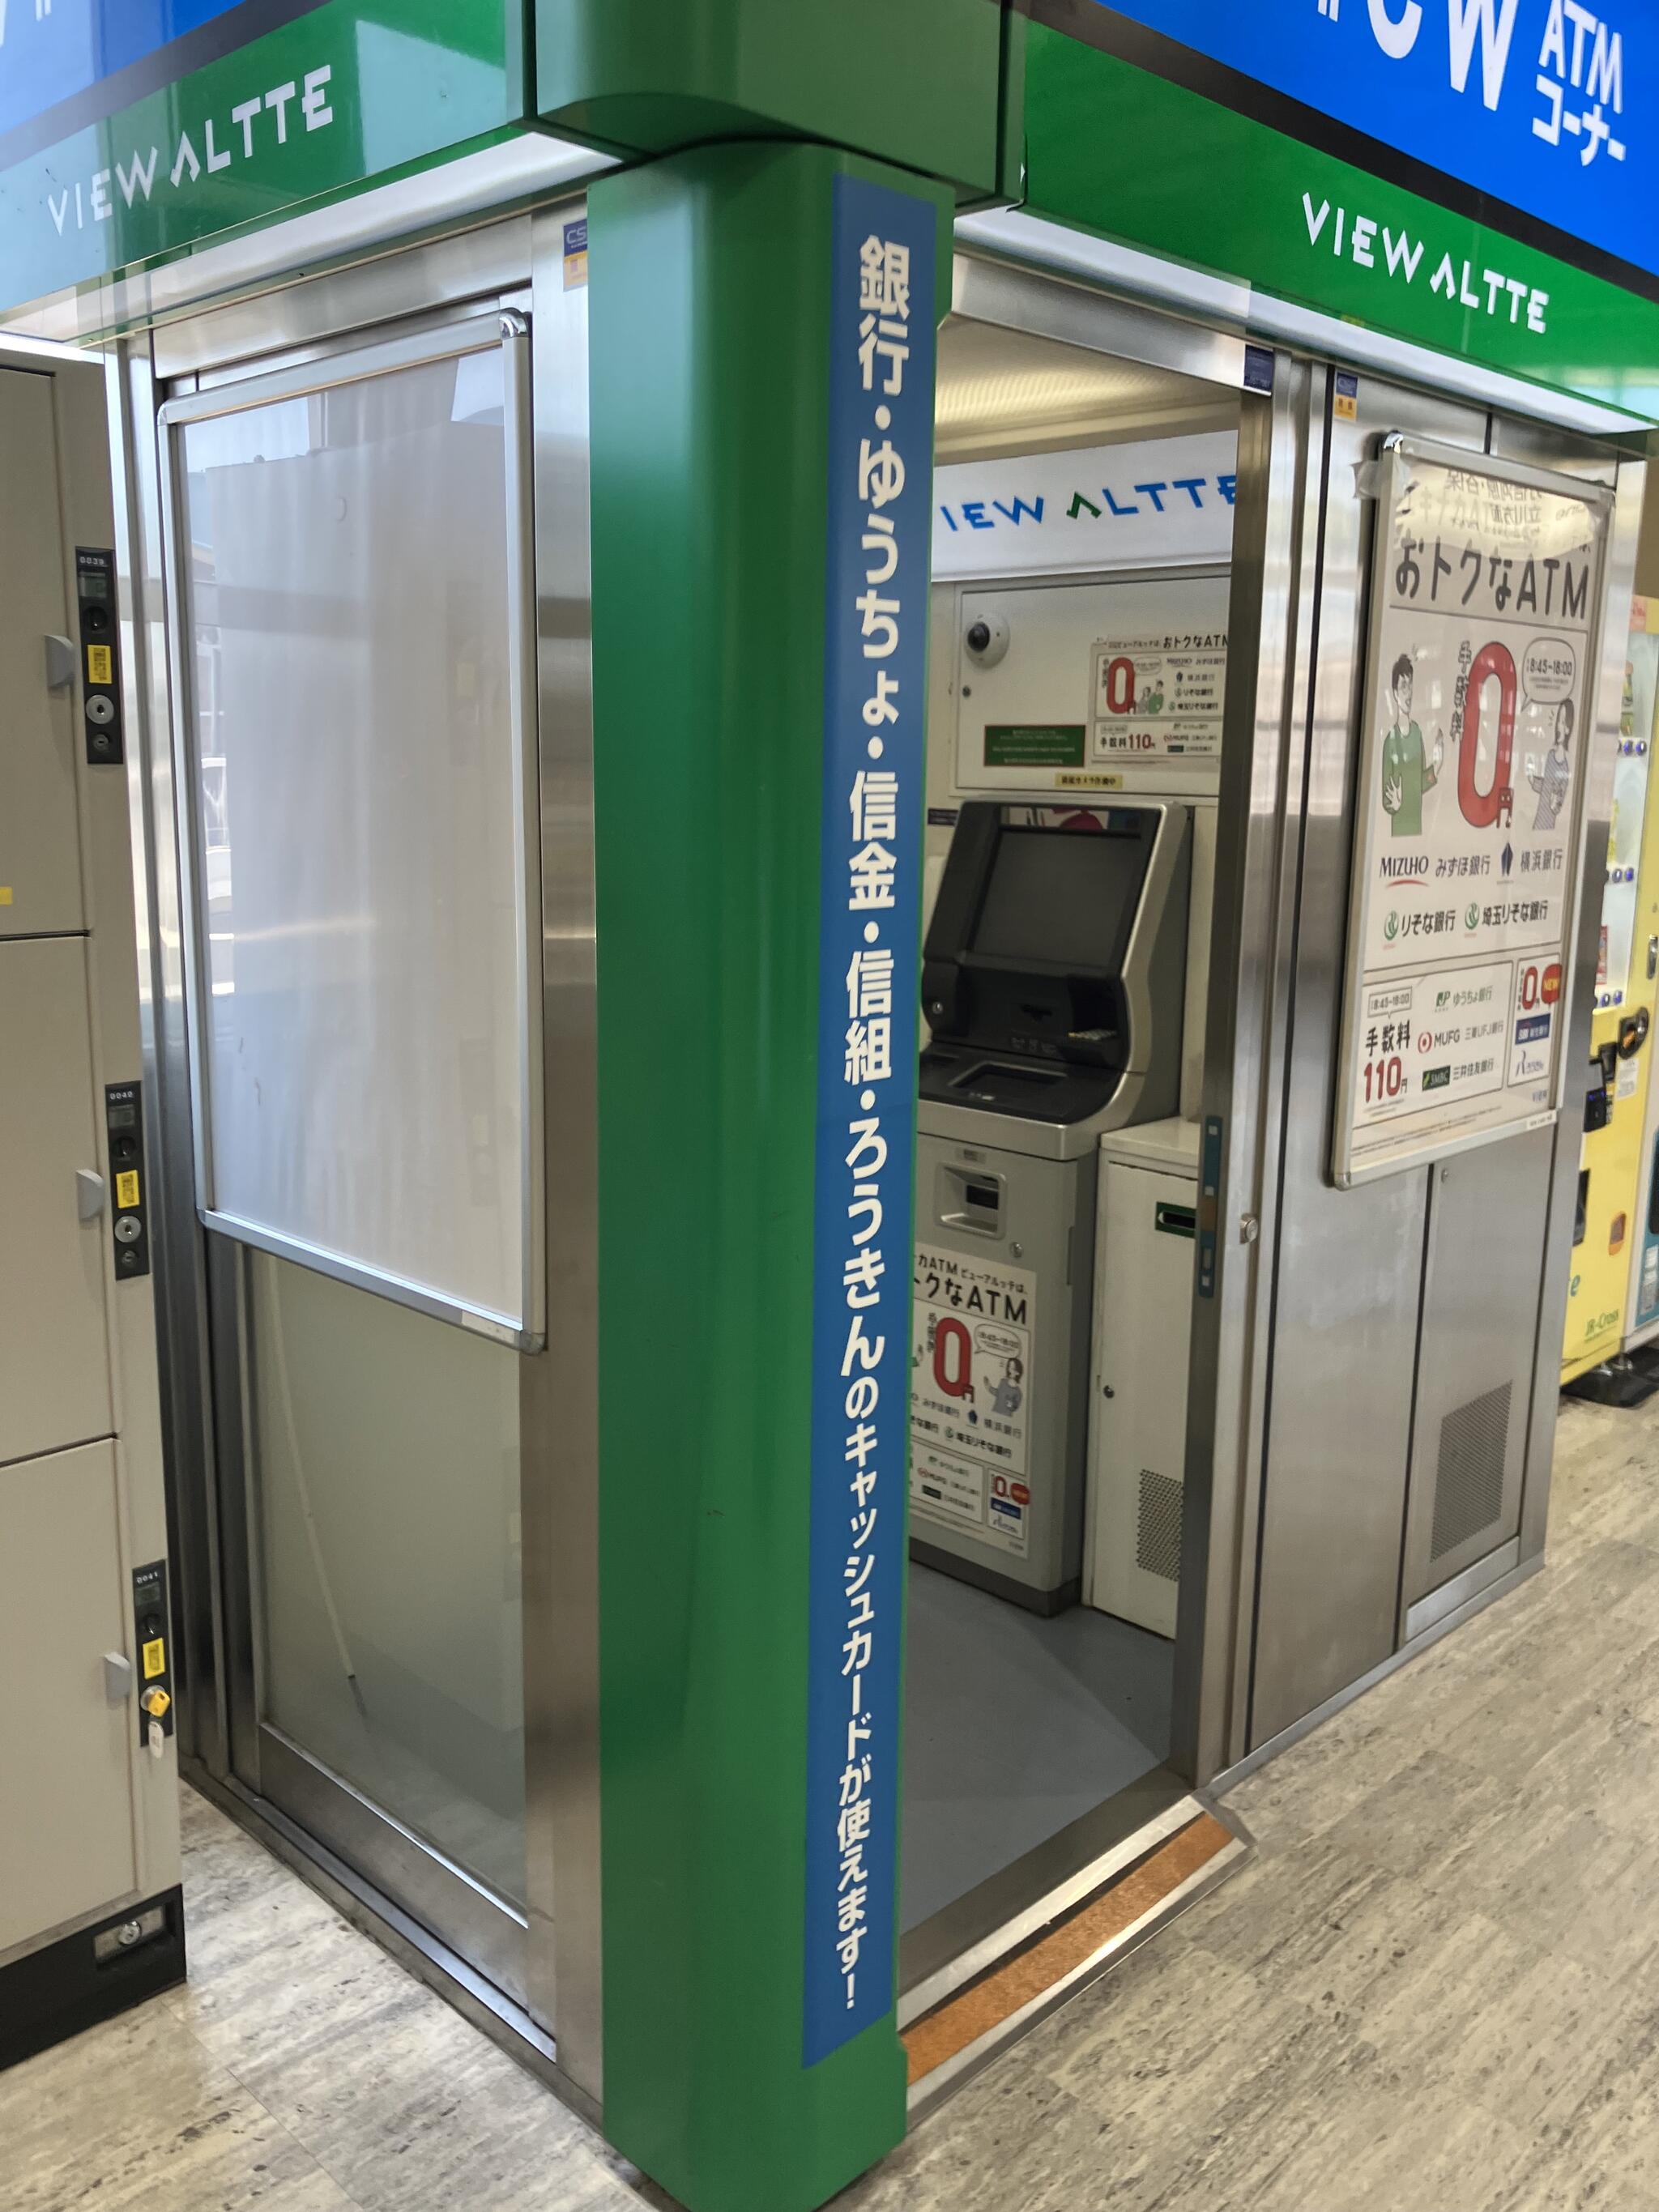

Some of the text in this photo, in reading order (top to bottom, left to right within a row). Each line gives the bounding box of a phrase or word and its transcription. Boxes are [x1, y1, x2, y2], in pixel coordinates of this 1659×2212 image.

[1538, 0, 1623, 114] ATM
[1532, 74, 1626, 166] コーナー
[47, 64, 333, 236] VIEW ALTTE
[566, 225, 588, 245] CS
[1302, 192, 1549, 334] VIEW ALTTE
[940, 495, 1044, 532] IEW
[1395, 528, 1589, 620] おトクなATM
[1380, 855, 1491, 878] MIZUHO みずほ銀行
[1520, 849, 1563, 873] 横浜銀行
[1401, 910, 1456, 937] りそな銀行
[1482, 900, 1549, 927] 埼玉りそな銀行
[1365, 1020, 1411, 1057] 手数料
[1434, 1029, 1461, 1047] MUFG
[915, 1254, 958, 1275] カATM
[914, 1272, 1027, 1325] クなATM
